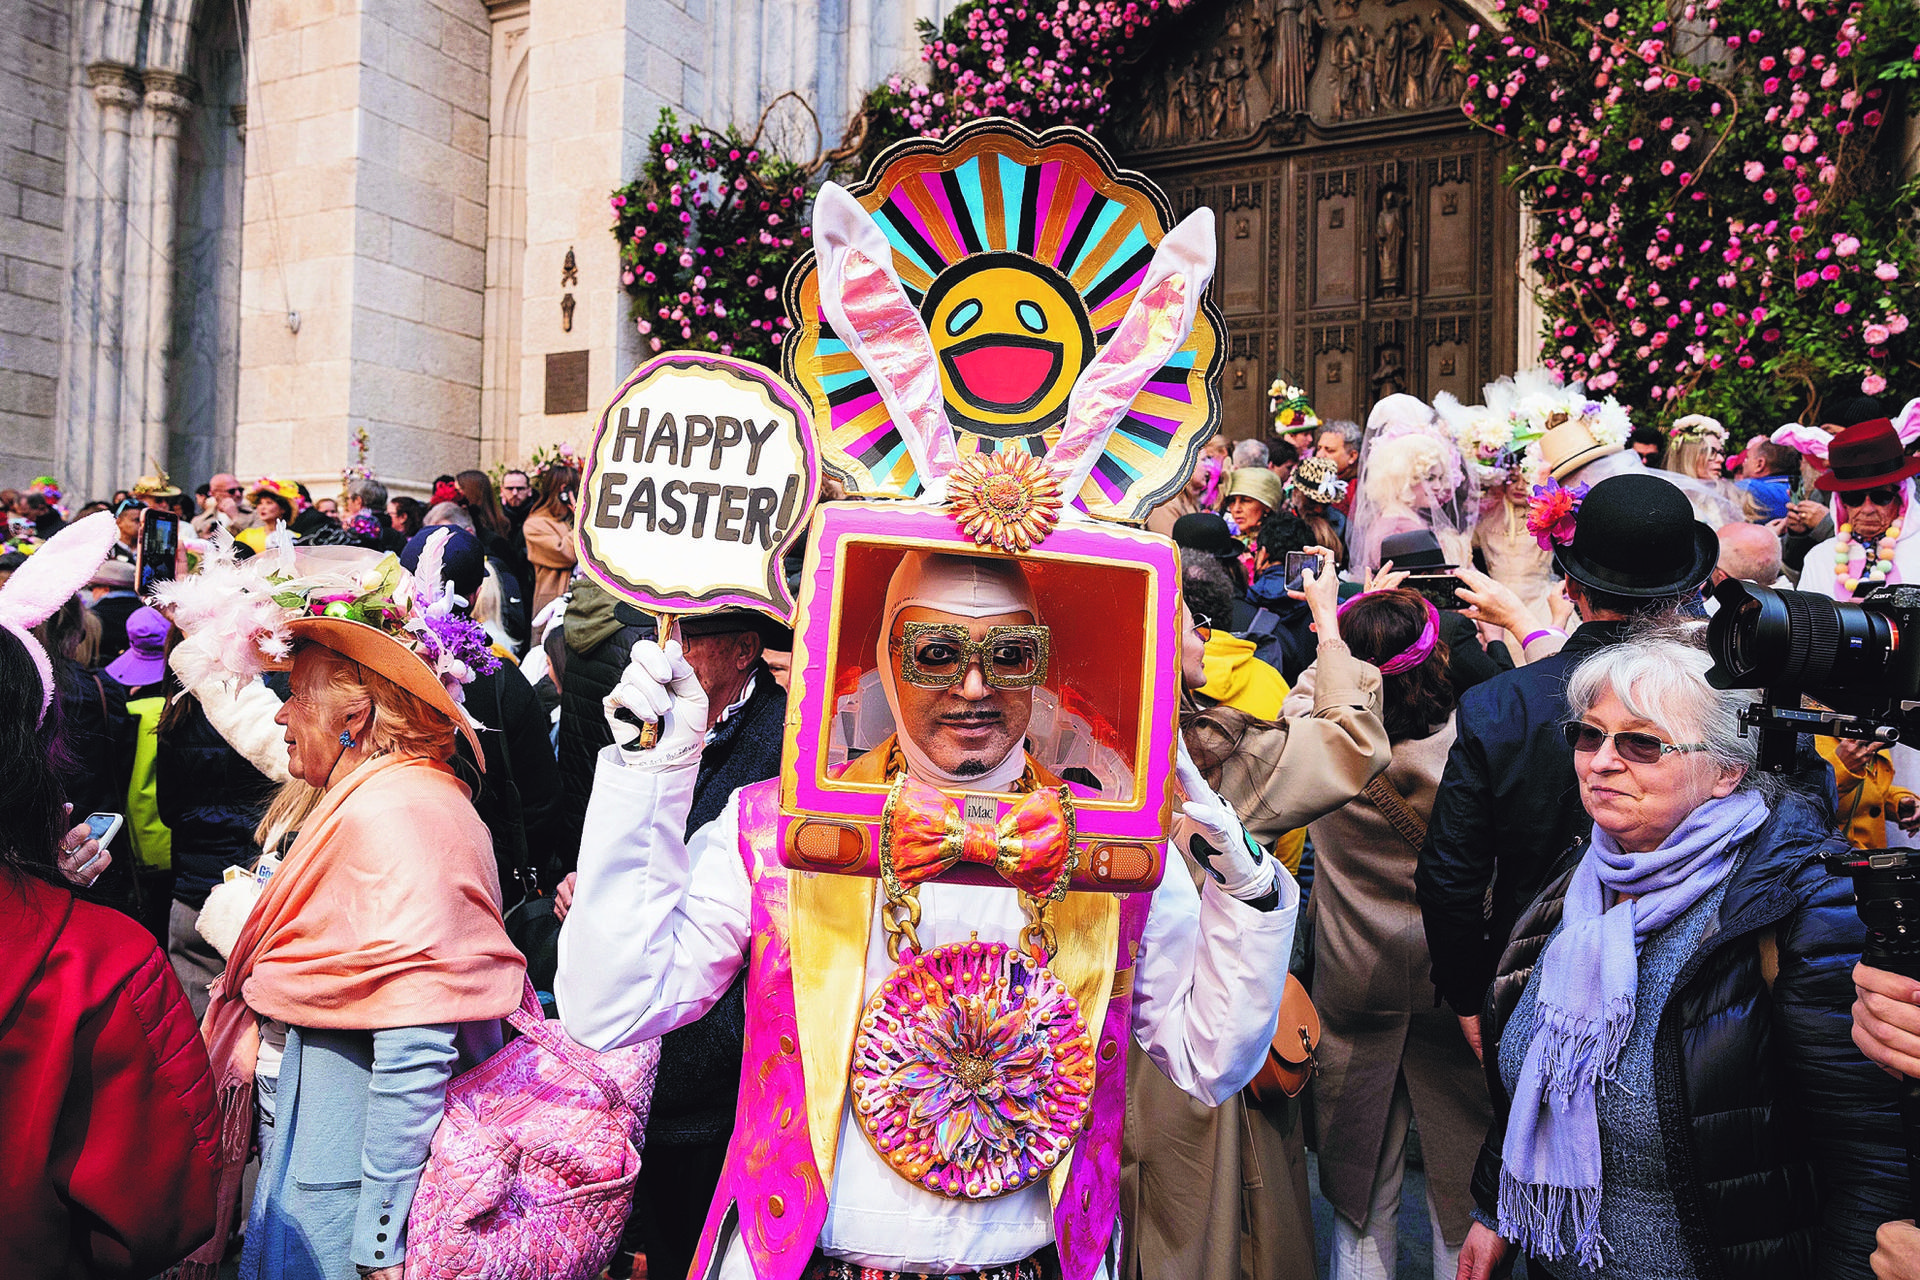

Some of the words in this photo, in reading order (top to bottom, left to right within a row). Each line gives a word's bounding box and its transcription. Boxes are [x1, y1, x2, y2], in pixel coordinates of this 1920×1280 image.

[612, 407, 779, 475] HAPPY
[594, 472, 800, 551] EASTER!
[967, 805, 994, 819] iMac
